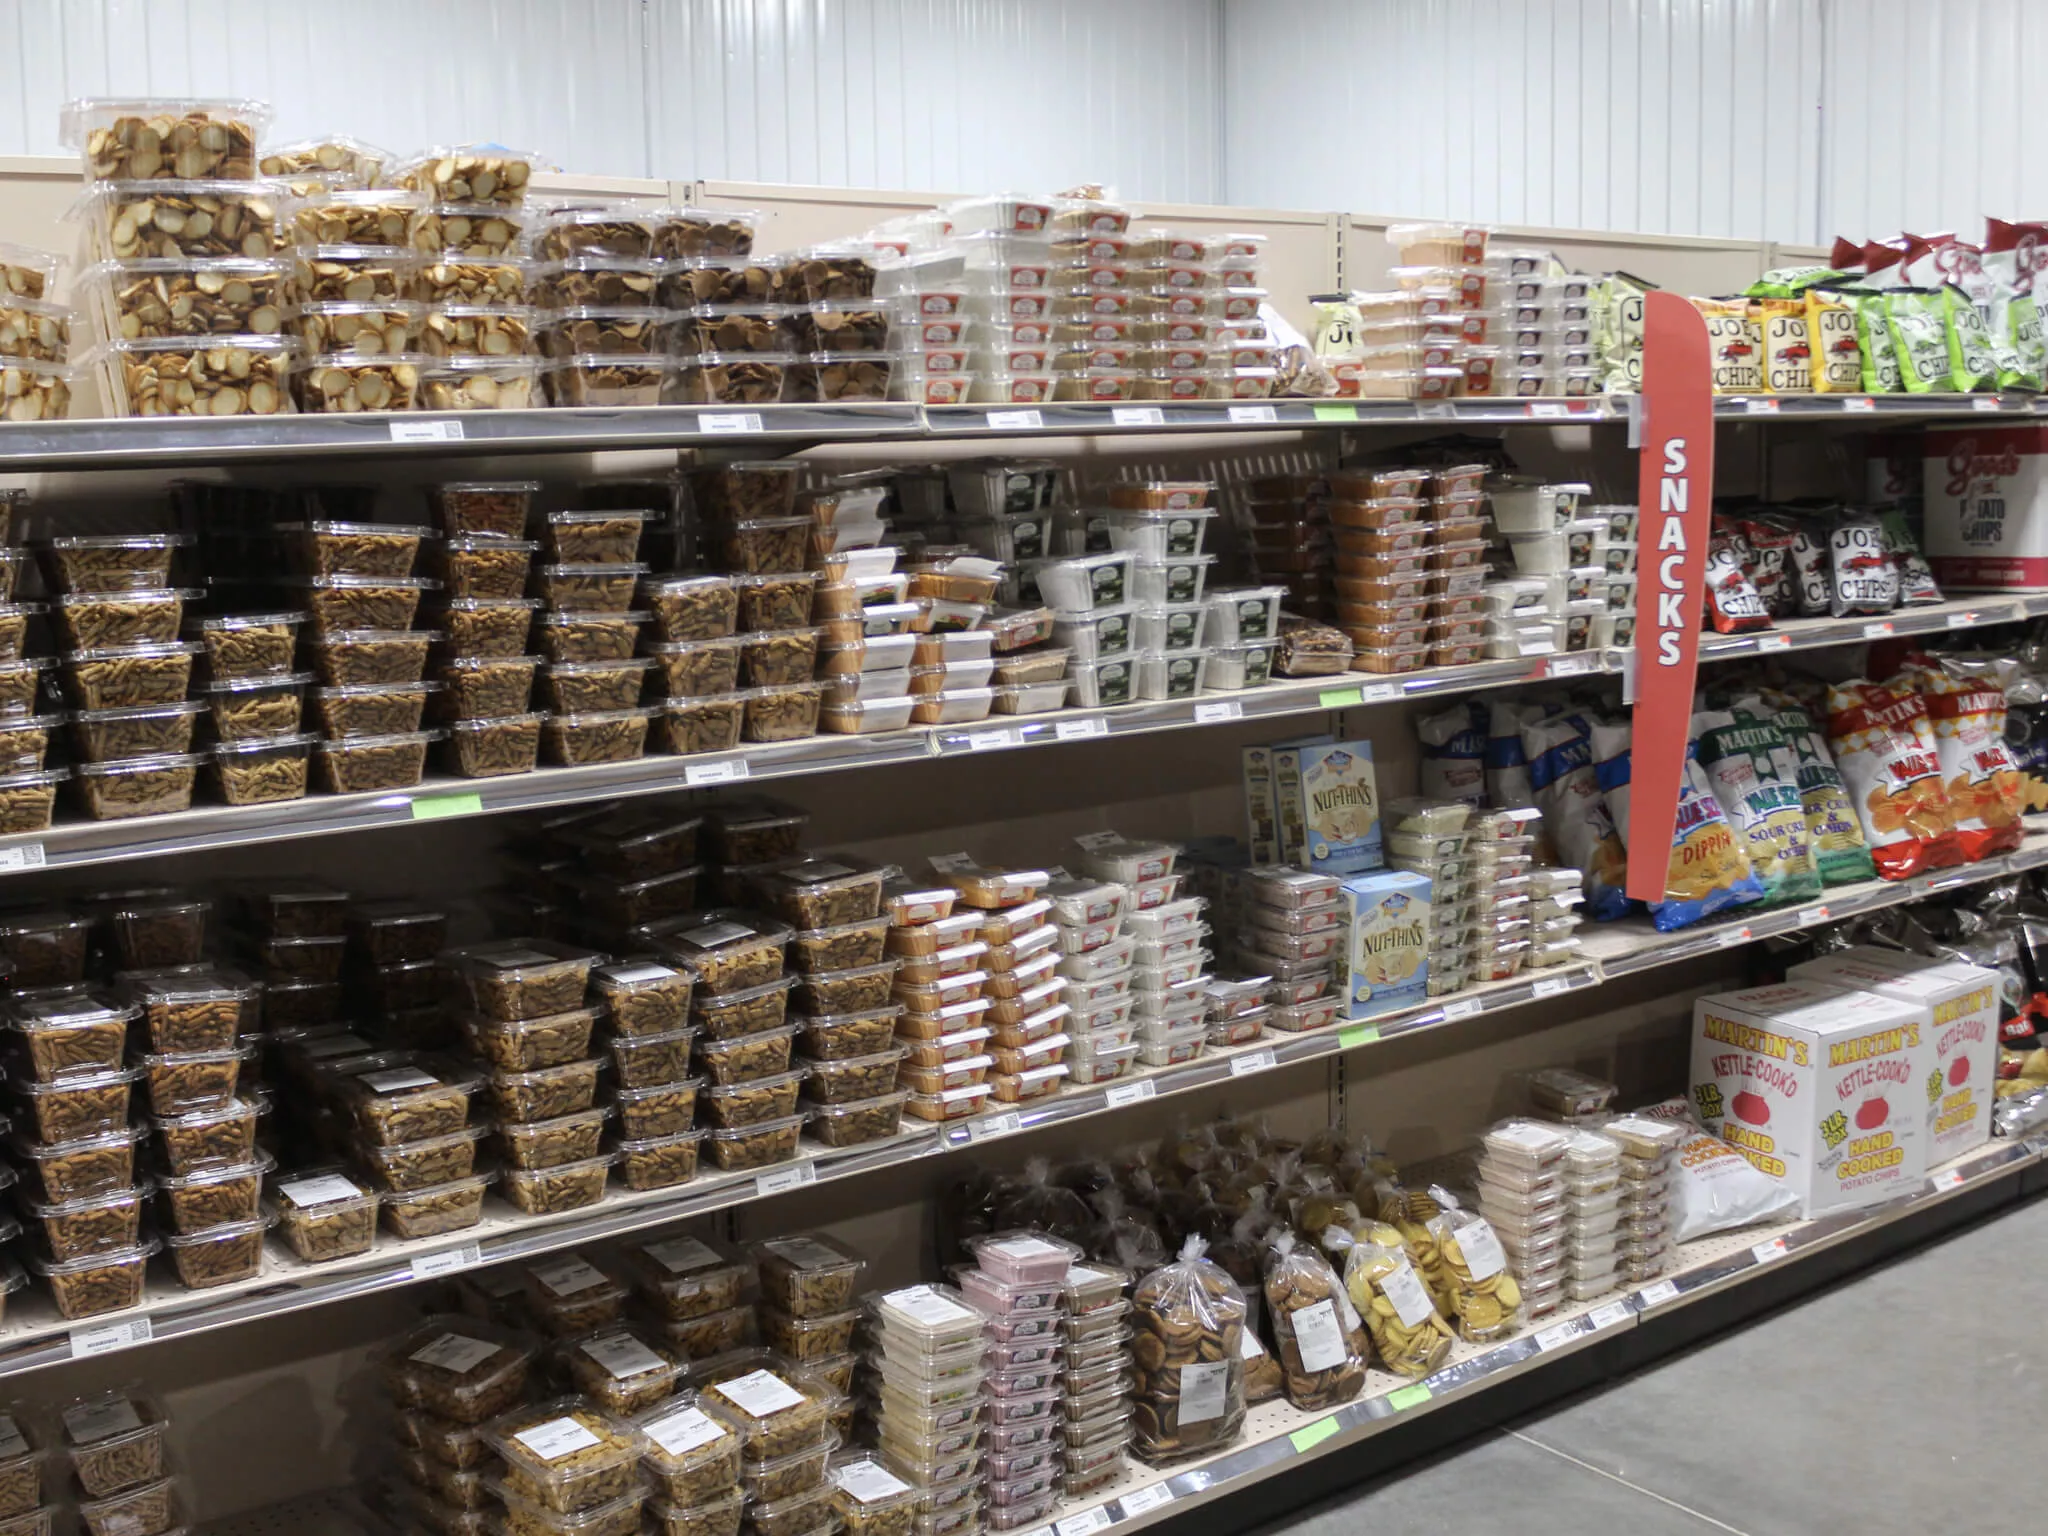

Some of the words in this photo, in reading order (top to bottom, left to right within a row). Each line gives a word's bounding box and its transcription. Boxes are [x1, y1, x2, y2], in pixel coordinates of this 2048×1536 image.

[1772, 319, 1807, 338] JO
[1960, 499, 2006, 519] PTATO
[1657, 437, 1689, 667] SNACKS
[1716, 727, 1783, 752] MARTIN'S
[1749, 826, 1786, 844] SOUR
[1703, 1013, 1809, 1067] MARTIN'S
[1828, 1022, 1920, 1068] MARTIN'S
[1711, 1053, 1798, 1098] KETTLE-COOK'D
[1836, 1057, 1911, 1101] KETTLE-COOK'D
[1723, 1122, 1775, 1154] HAND
[1848, 1130, 1895, 1159] HAND
[1728, 1145, 1786, 1178] KED
[1836, 1147, 1905, 1180] COOKED
[1840, 1175, 1873, 1192] POTATO
